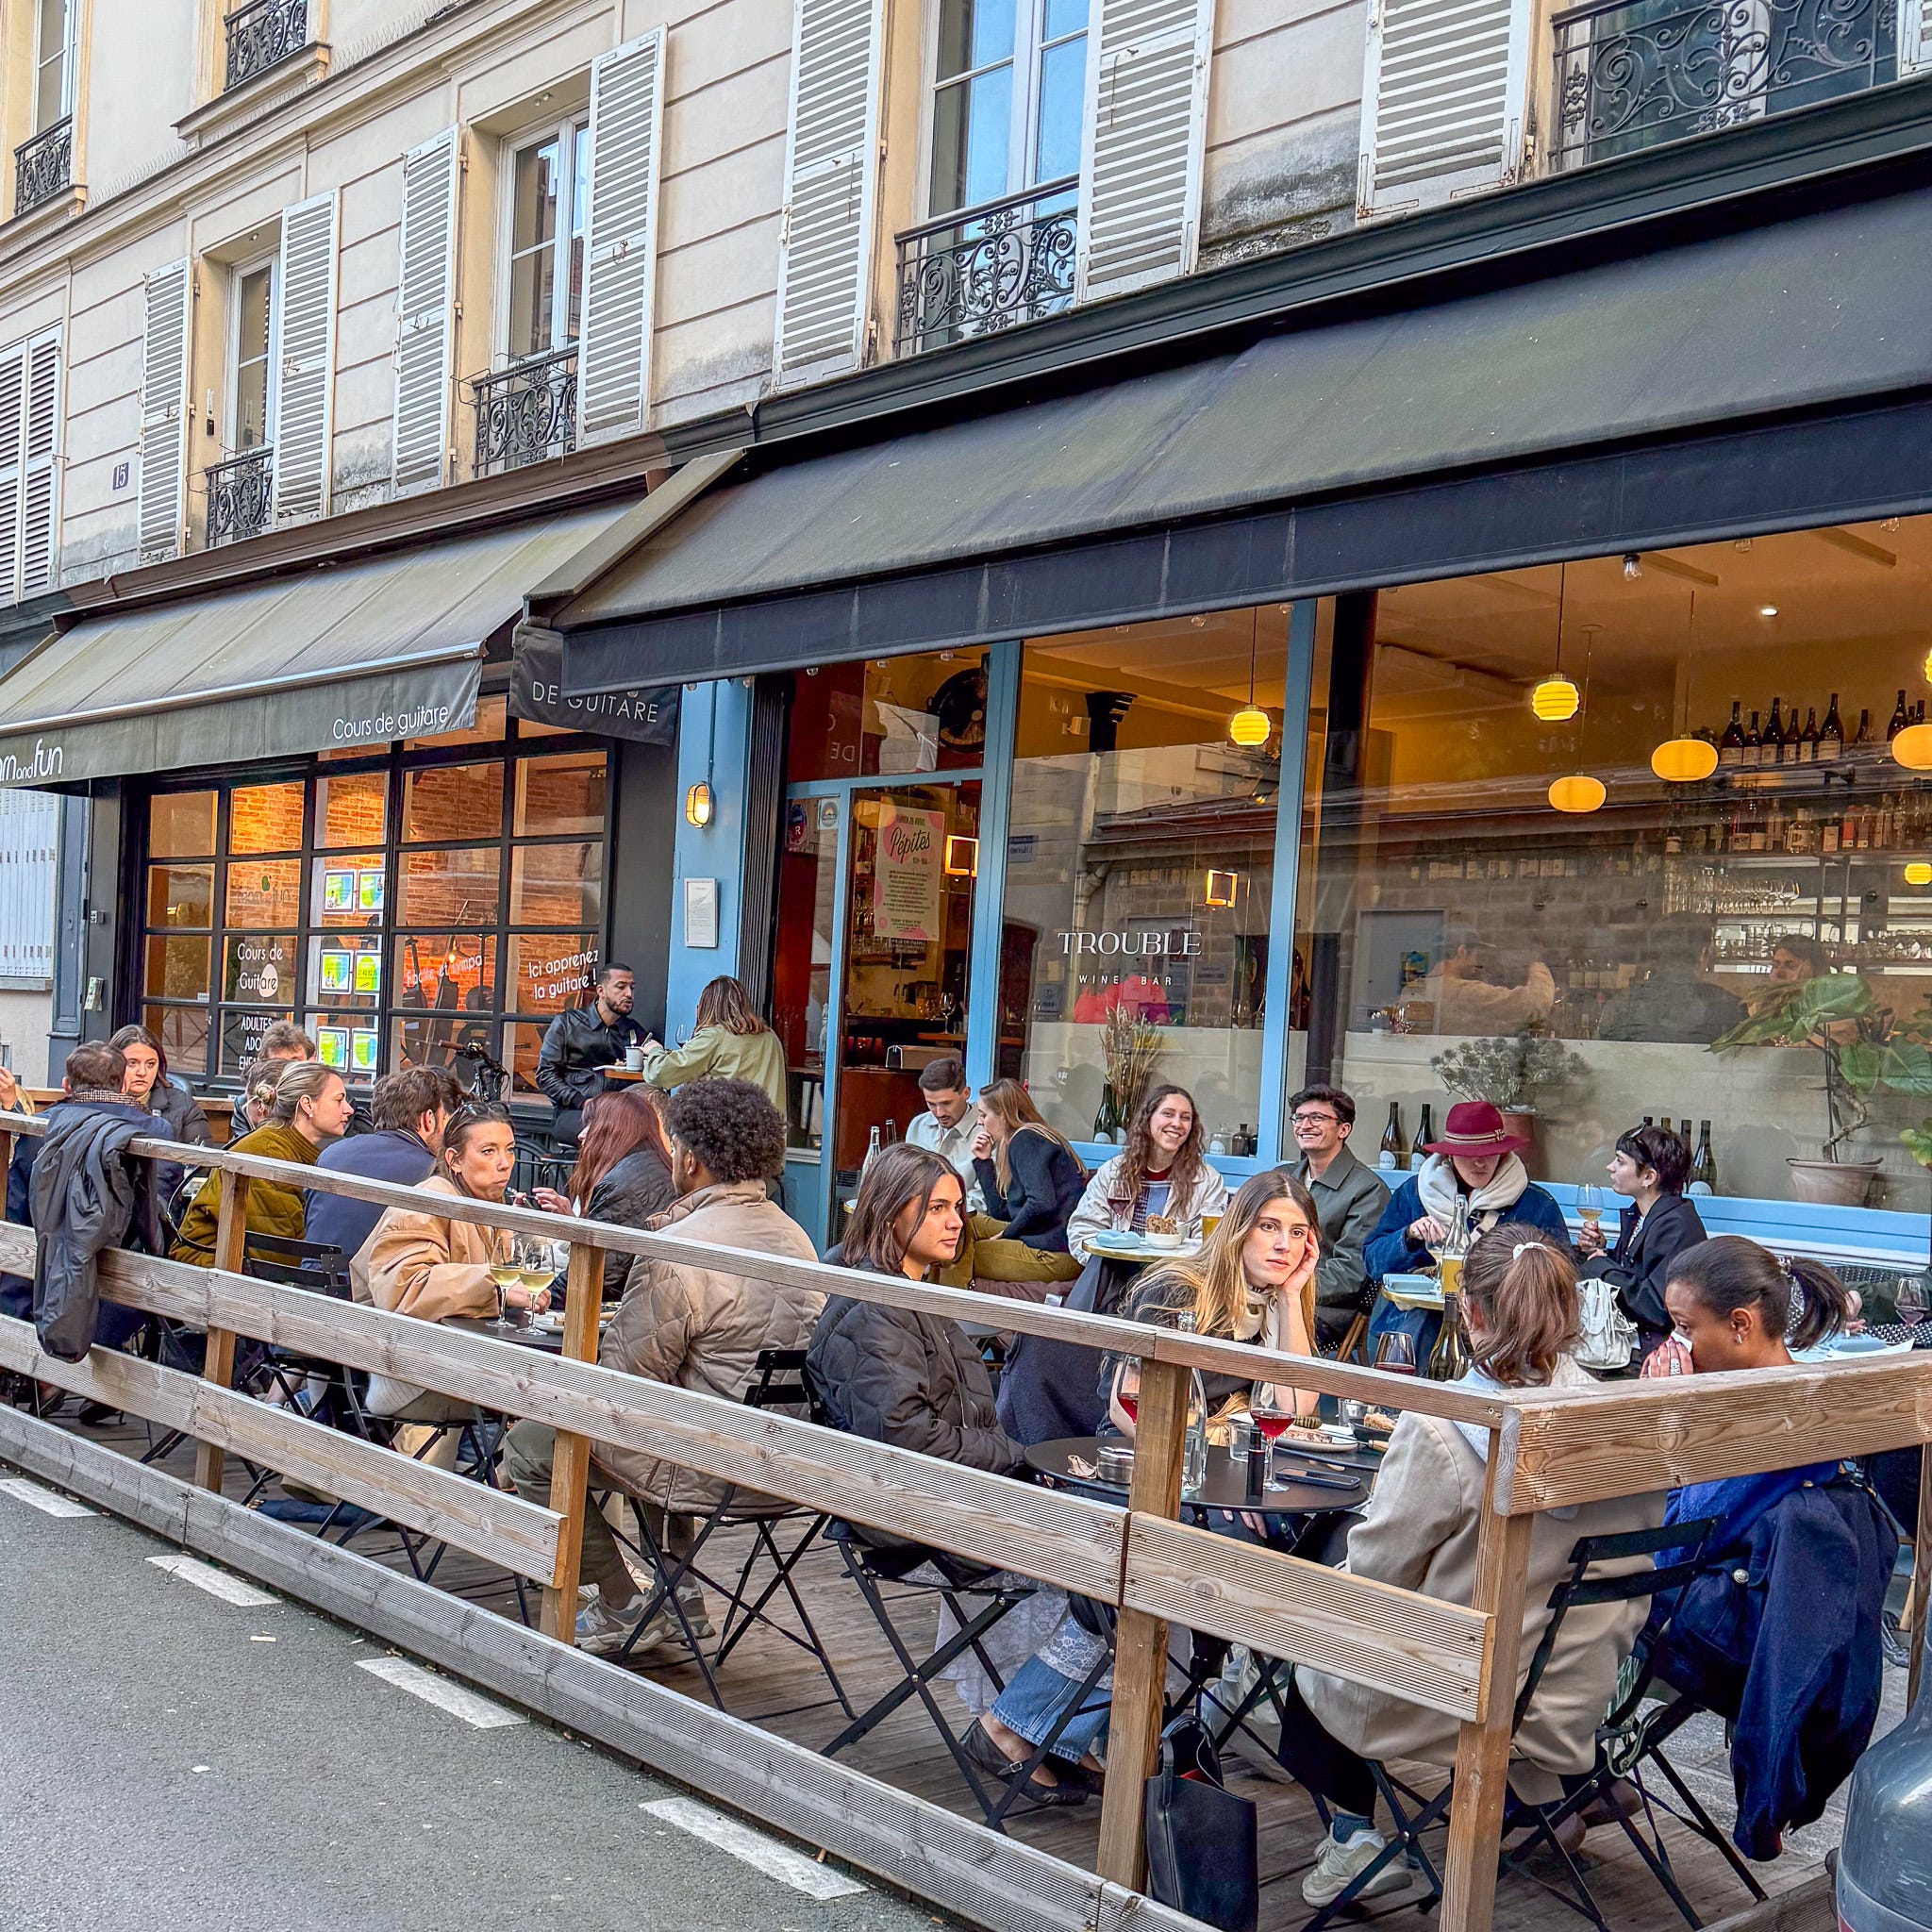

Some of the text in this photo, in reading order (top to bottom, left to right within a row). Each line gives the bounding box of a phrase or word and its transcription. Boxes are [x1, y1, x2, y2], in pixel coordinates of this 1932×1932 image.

[115, 464, 126, 488] 15
[533, 681, 558, 705] DE
[333, 706, 449, 740] Cours de guitare
[890, 826, 930, 864] Pépites
[237, 943, 283, 960] Cours de
[1058, 932, 1202, 956] TROUBLE
[528, 950, 599, 979] Ici apprenez
[240, 973, 277, 991] Guitare
[534, 983, 545, 1000] la
[548, 974, 590, 999] guitare
[1078, 974, 1172, 986] WINE BAR
[241, 1016, 272, 1032] ADULTES
[244, 1037, 262, 1052] ADO
